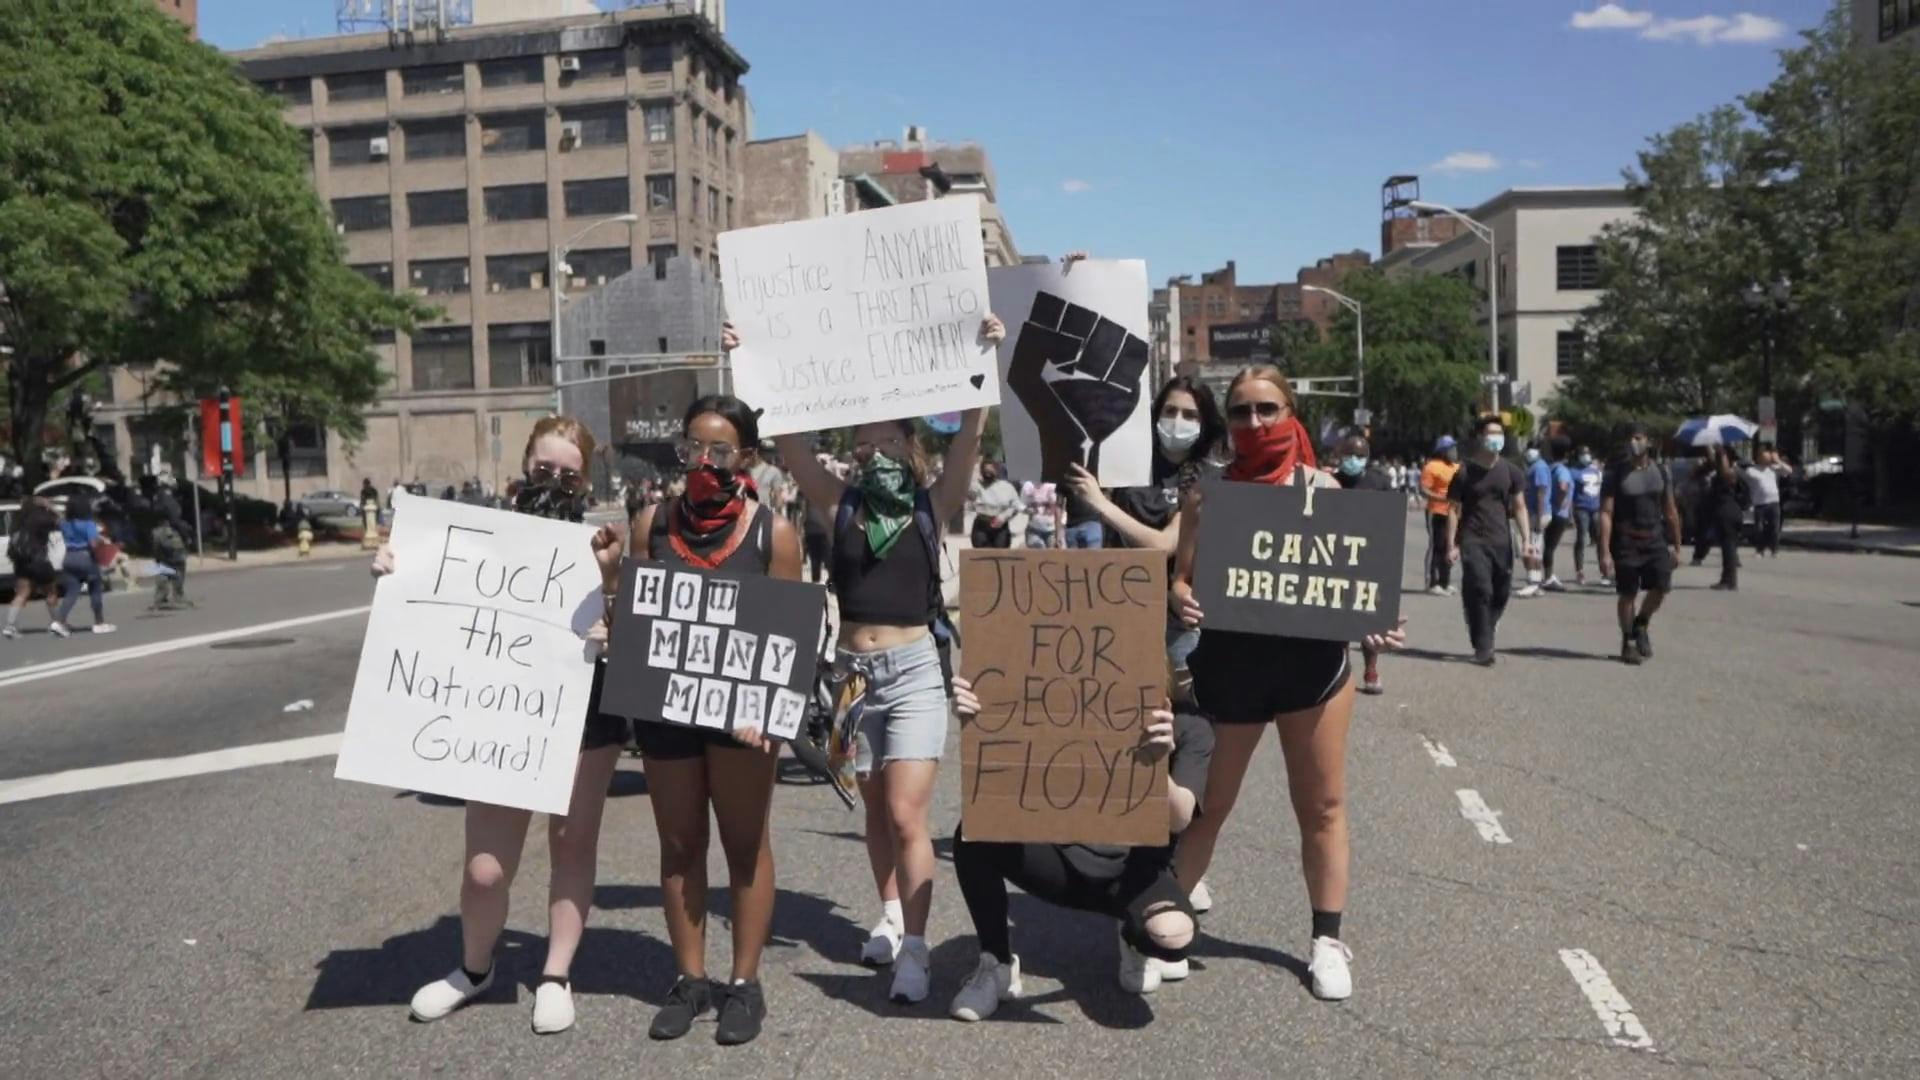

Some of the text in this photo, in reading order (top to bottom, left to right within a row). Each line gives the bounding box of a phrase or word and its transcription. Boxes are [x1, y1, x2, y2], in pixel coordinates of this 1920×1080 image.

[767, 282, 978, 340] is a THREAT to
[768, 353, 856, 393] Justice
[433, 525, 576, 608] Fuck
[638, 575, 738, 611] HOW
[1226, 567, 1379, 612] BREATH
[460, 608, 532, 667] the
[652, 628, 796, 673] MANY
[1030, 624, 1126, 676] FOR
[387, 648, 564, 728] National
[664, 679, 801, 730] MORE
[969, 668, 1160, 733] GEORGE
[412, 715, 548, 781] Guard!
[971, 740, 1157, 817] FLOYD
